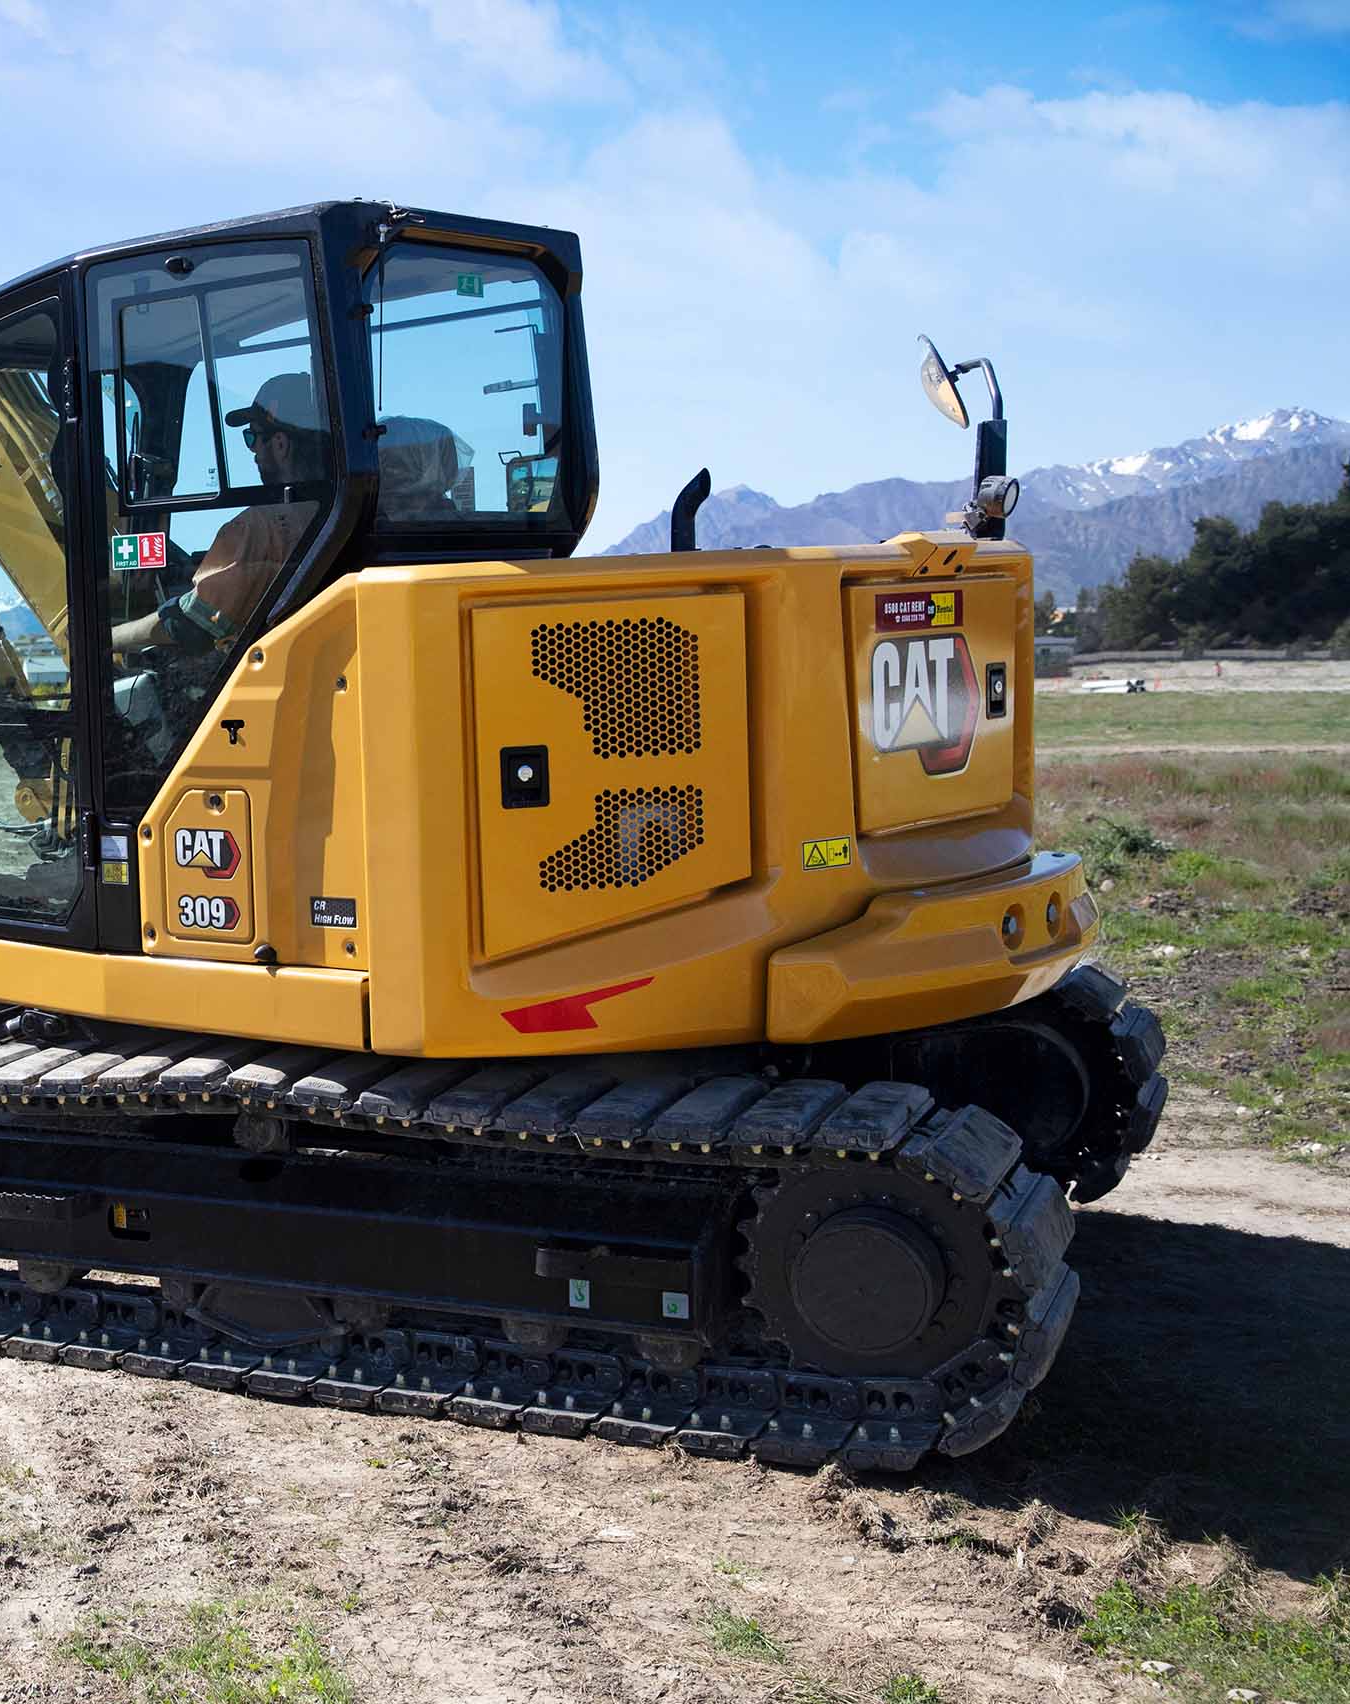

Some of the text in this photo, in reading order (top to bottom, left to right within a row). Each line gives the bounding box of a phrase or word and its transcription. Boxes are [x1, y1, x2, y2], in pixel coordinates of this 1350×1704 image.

[899, 601, 911, 613] CAT
[911, 600, 925, 612] RENT
[872, 637, 955, 748] CAT
[176, 829, 225, 867] CAT
[180, 897, 226, 928] 309
[313, 900, 326, 910] CR
